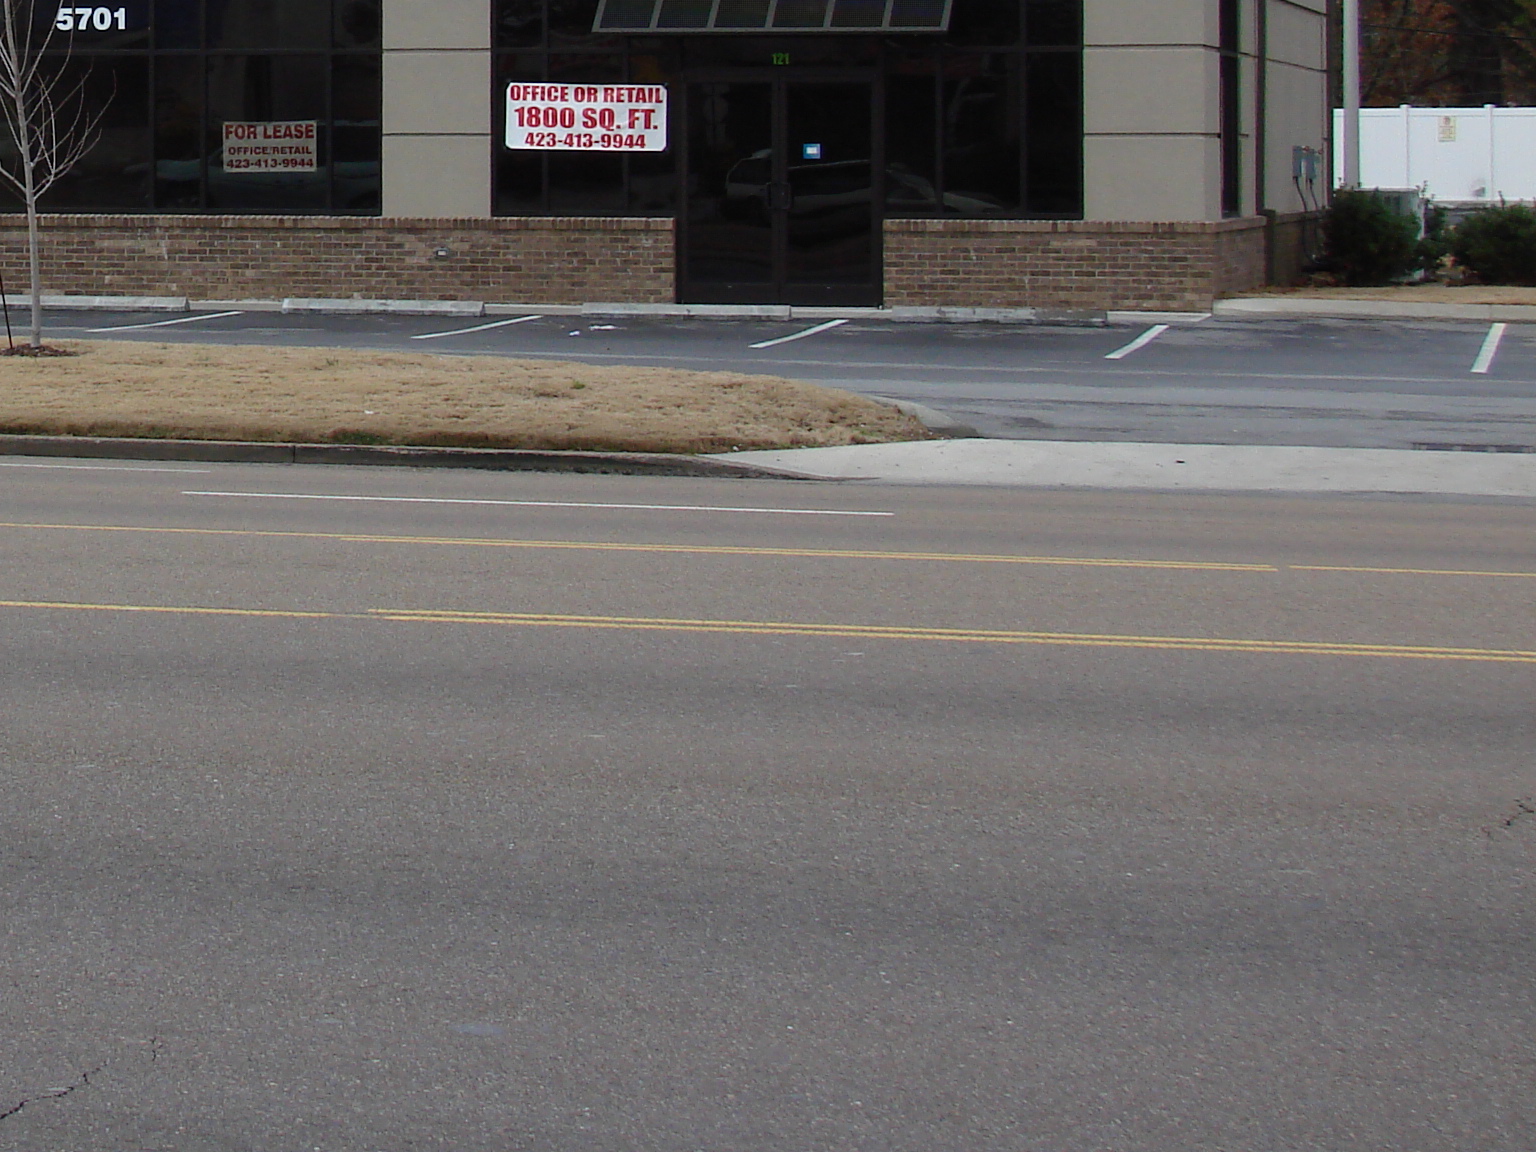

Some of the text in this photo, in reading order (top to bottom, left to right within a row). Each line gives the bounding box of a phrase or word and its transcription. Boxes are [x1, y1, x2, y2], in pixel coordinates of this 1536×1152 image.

[55, 6, 127, 31] 5701
[510, 85, 663, 104] OFFICE OR RETAIL
[514, 106, 659, 132] 1800 SQ. FT.
[225, 123, 314, 140] FOR LEASE
[524, 131, 646, 149] 423-413-9944
[226, 157, 314, 169] 423-413-9944
